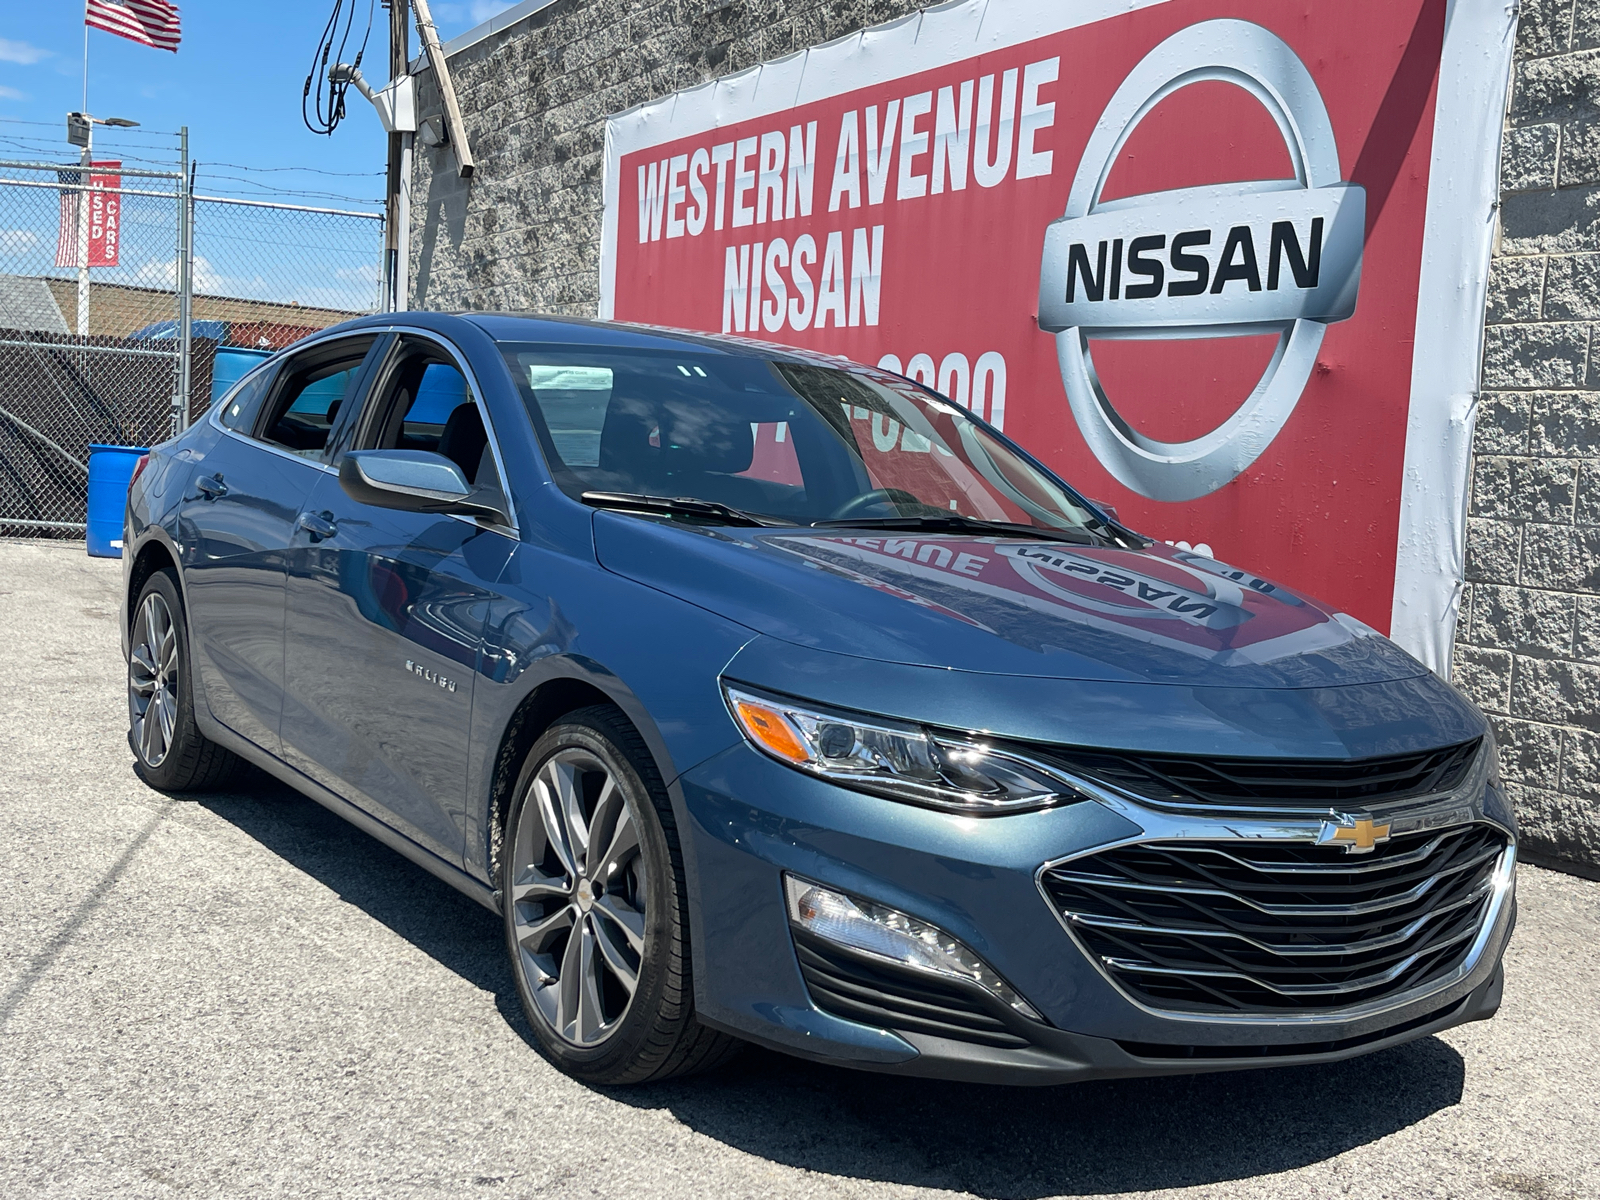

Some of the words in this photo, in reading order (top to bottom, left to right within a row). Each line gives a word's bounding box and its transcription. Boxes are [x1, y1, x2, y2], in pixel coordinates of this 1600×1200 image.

[637, 120, 818, 244] WESTERN
[828, 56, 1061, 213] AVENUE
[91, 180, 104, 240] USED
[105, 200, 118, 259] CARS
[722, 225, 886, 334] NISSAN
[1065, 216, 1325, 304] NISSAN
[405, 659, 458, 693] MALIBU
